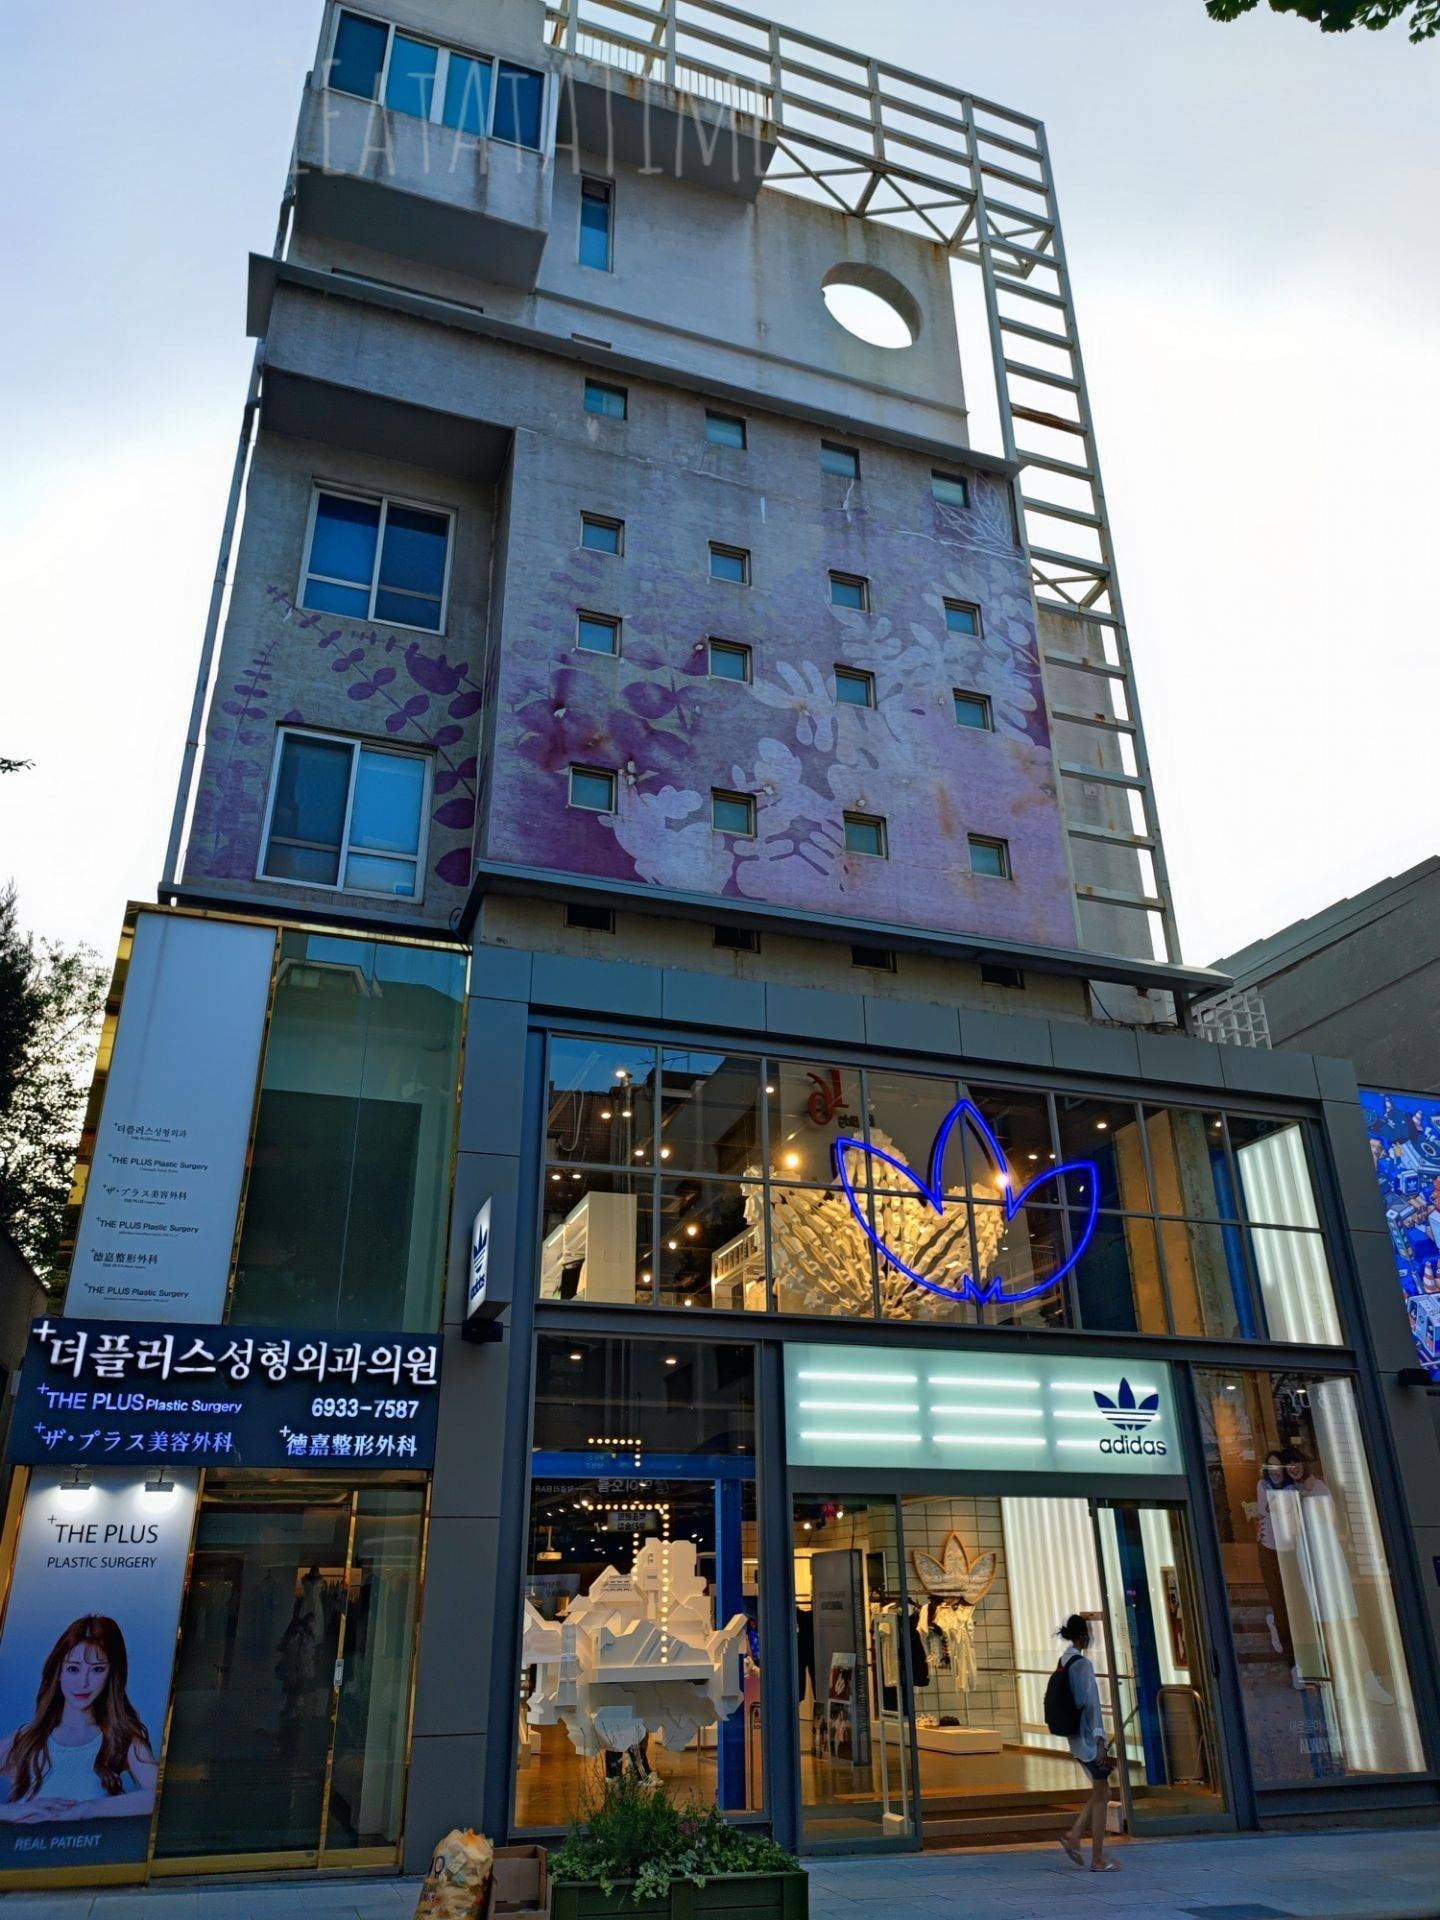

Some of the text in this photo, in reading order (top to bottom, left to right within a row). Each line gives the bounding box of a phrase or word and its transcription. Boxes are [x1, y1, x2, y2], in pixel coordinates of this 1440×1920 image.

[111, 1156, 128, 1165] THE
[130, 1158, 153, 1167] PLUS
[154, 1160, 178, 1169] Plastic
[179, 1162, 208, 1171] Surgery
[100, 1219, 199, 1234] THE PLUS Plastic Surgery
[87, 1285, 189, 1298] THE PLUS Plastic Surgery
[50, 1331, 438, 1386] 더플러스성형외과의원
[46, 1391, 242, 1414] THE PLUS Plastic Surgery
[311, 1397, 420, 1419] 6933-7587
[285, 1432, 418, 1458] 德嘉整形外科
[1099, 1434, 1168, 1456] adidas
[55, 1524, 159, 1544] THE PLUS
[46, 1556, 158, 1569] PLASTIC SURGERY
[15, 1833, 103, 1851] REAL PATIENT
